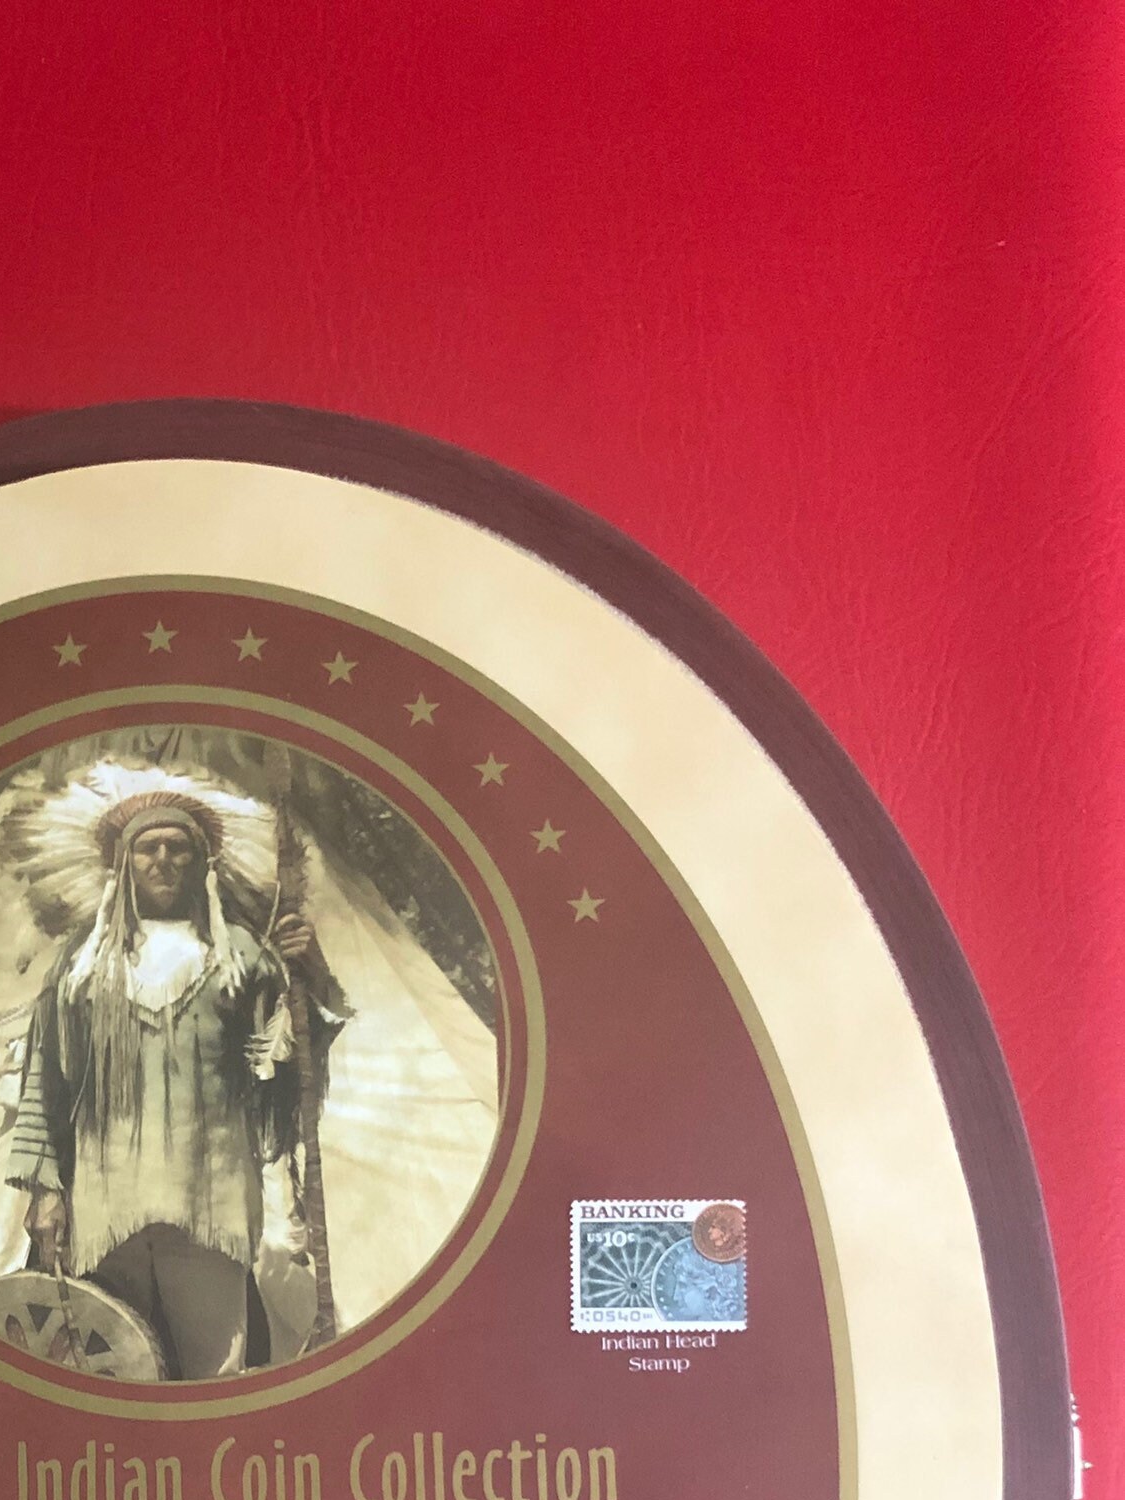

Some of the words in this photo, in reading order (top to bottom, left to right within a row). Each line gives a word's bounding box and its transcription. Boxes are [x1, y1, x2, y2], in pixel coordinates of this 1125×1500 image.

[580, 1204, 686, 1219] BANKING
[602, 1335, 659, 1350] Indian
[666, 1333, 716, 1348] Head
[629, 1356, 690, 1373] Stamp
